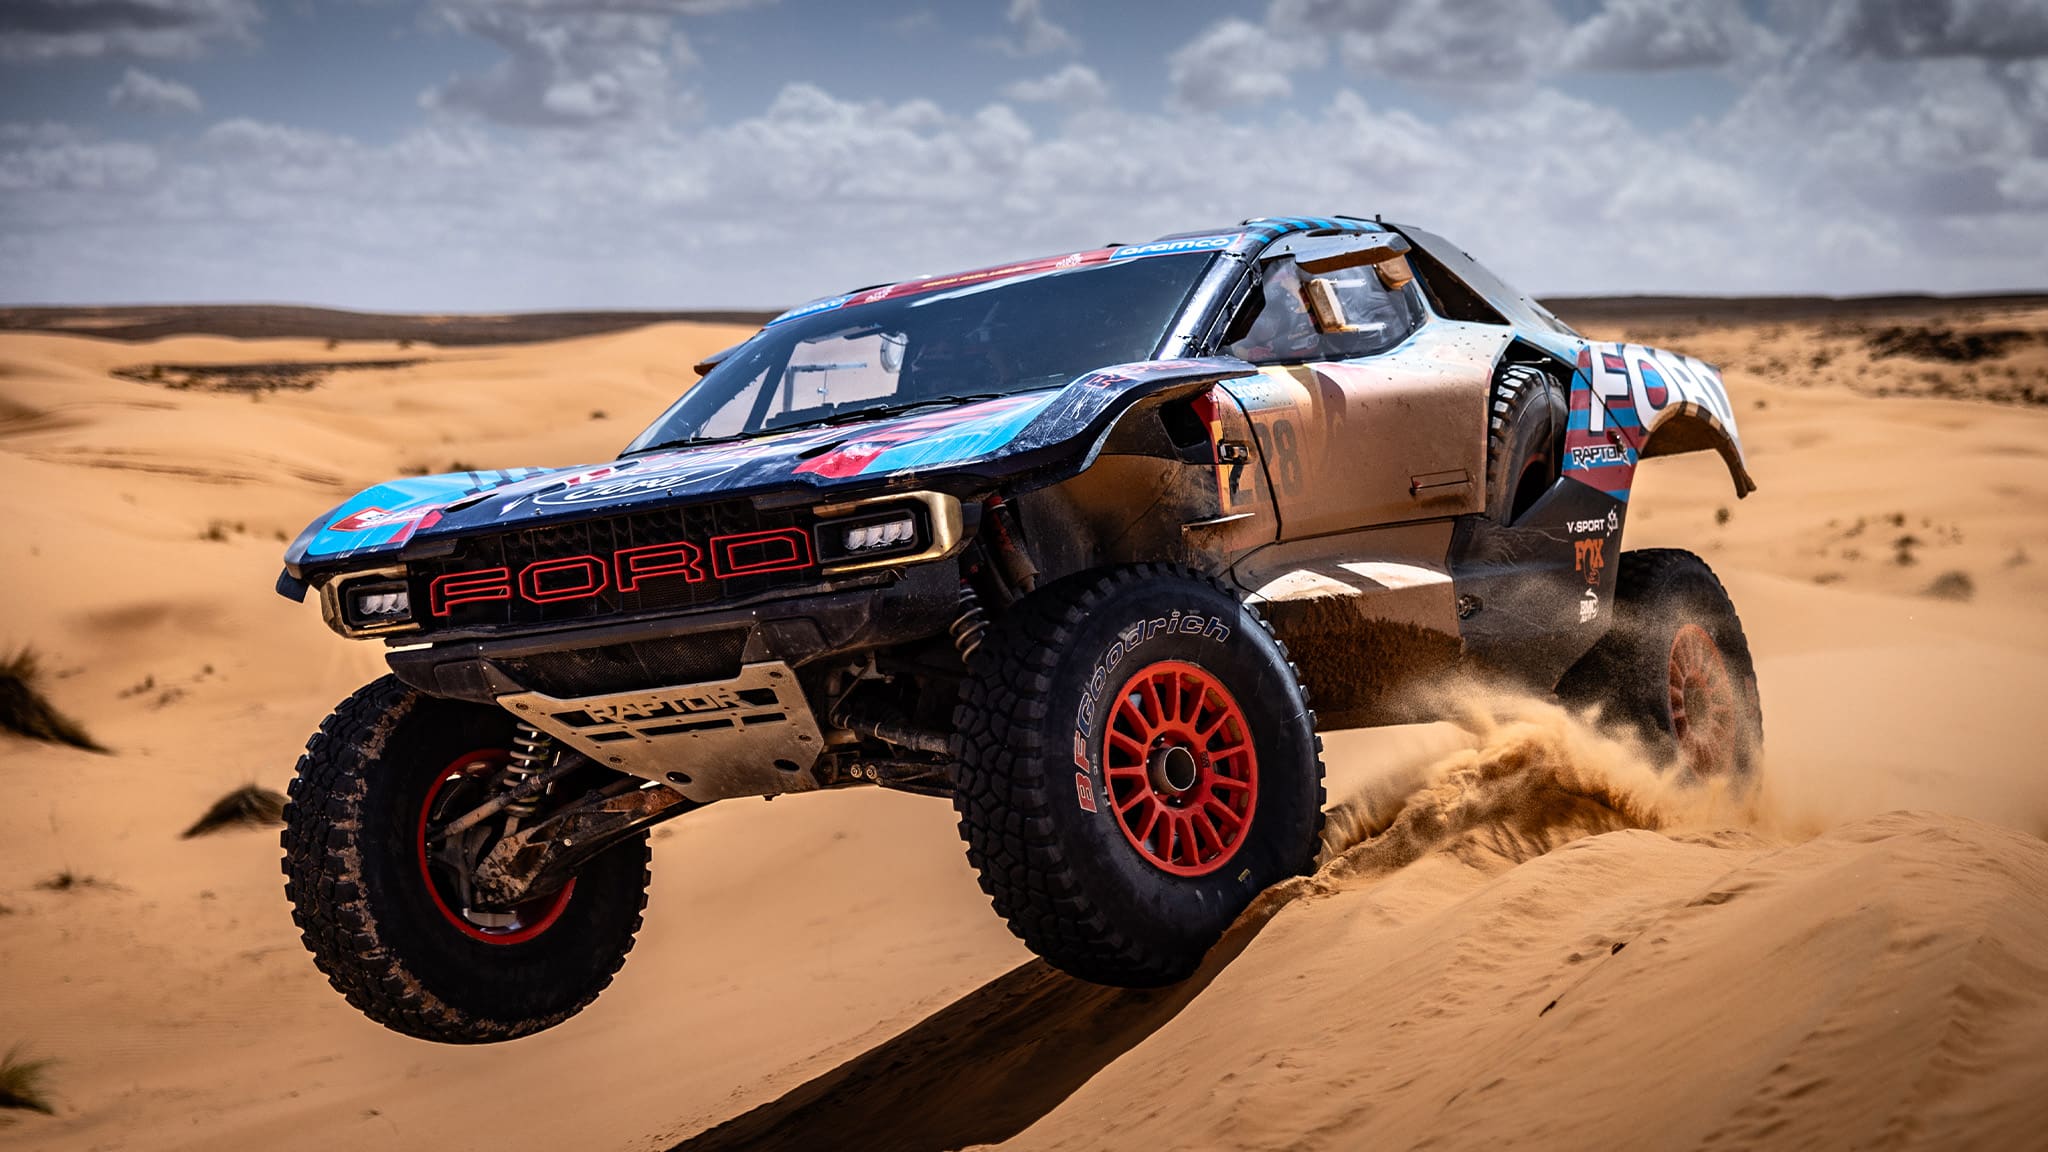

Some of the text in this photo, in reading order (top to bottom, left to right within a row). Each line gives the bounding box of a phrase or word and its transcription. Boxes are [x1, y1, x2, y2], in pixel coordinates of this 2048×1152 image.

[1119, 238, 1230, 255] aramco
[1571, 445, 1632, 472] RAPTOR
[430, 527, 814, 616] FORD
[1574, 538, 1604, 574] FOX
[585, 692, 746, 725] RAPTOR
[1073, 611, 1231, 813] BFGoodrich
